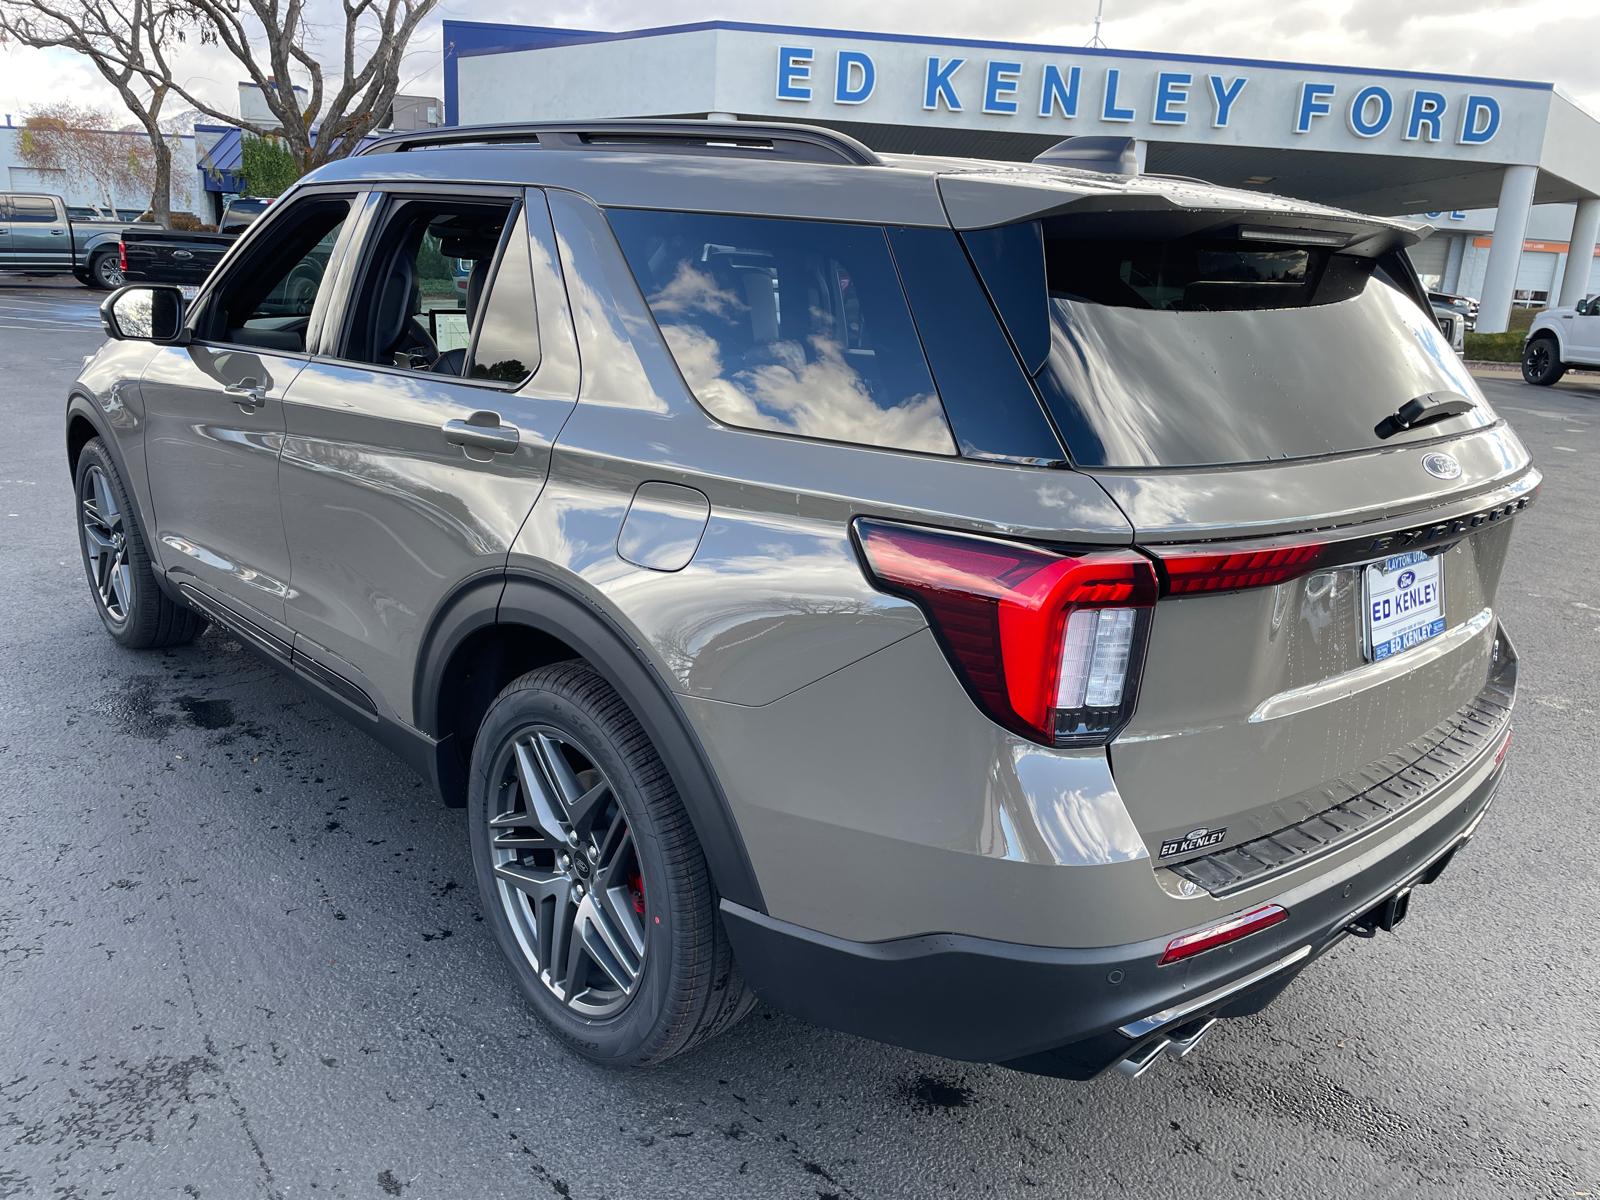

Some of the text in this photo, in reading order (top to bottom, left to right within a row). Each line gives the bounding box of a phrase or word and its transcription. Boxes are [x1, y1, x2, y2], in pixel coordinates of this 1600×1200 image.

[775, 45, 1502, 145] ED KENLEY FORD
[1370, 496, 1530, 552] EXPLORER
[1400, 572, 1413, 588] Ford
[1373, 581, 1438, 622] ED KENLEY
[1390, 637, 1401, 653] ED
[1403, 623, 1433, 649] KENLEY
[1161, 831, 1226, 856] ED KENLEY
